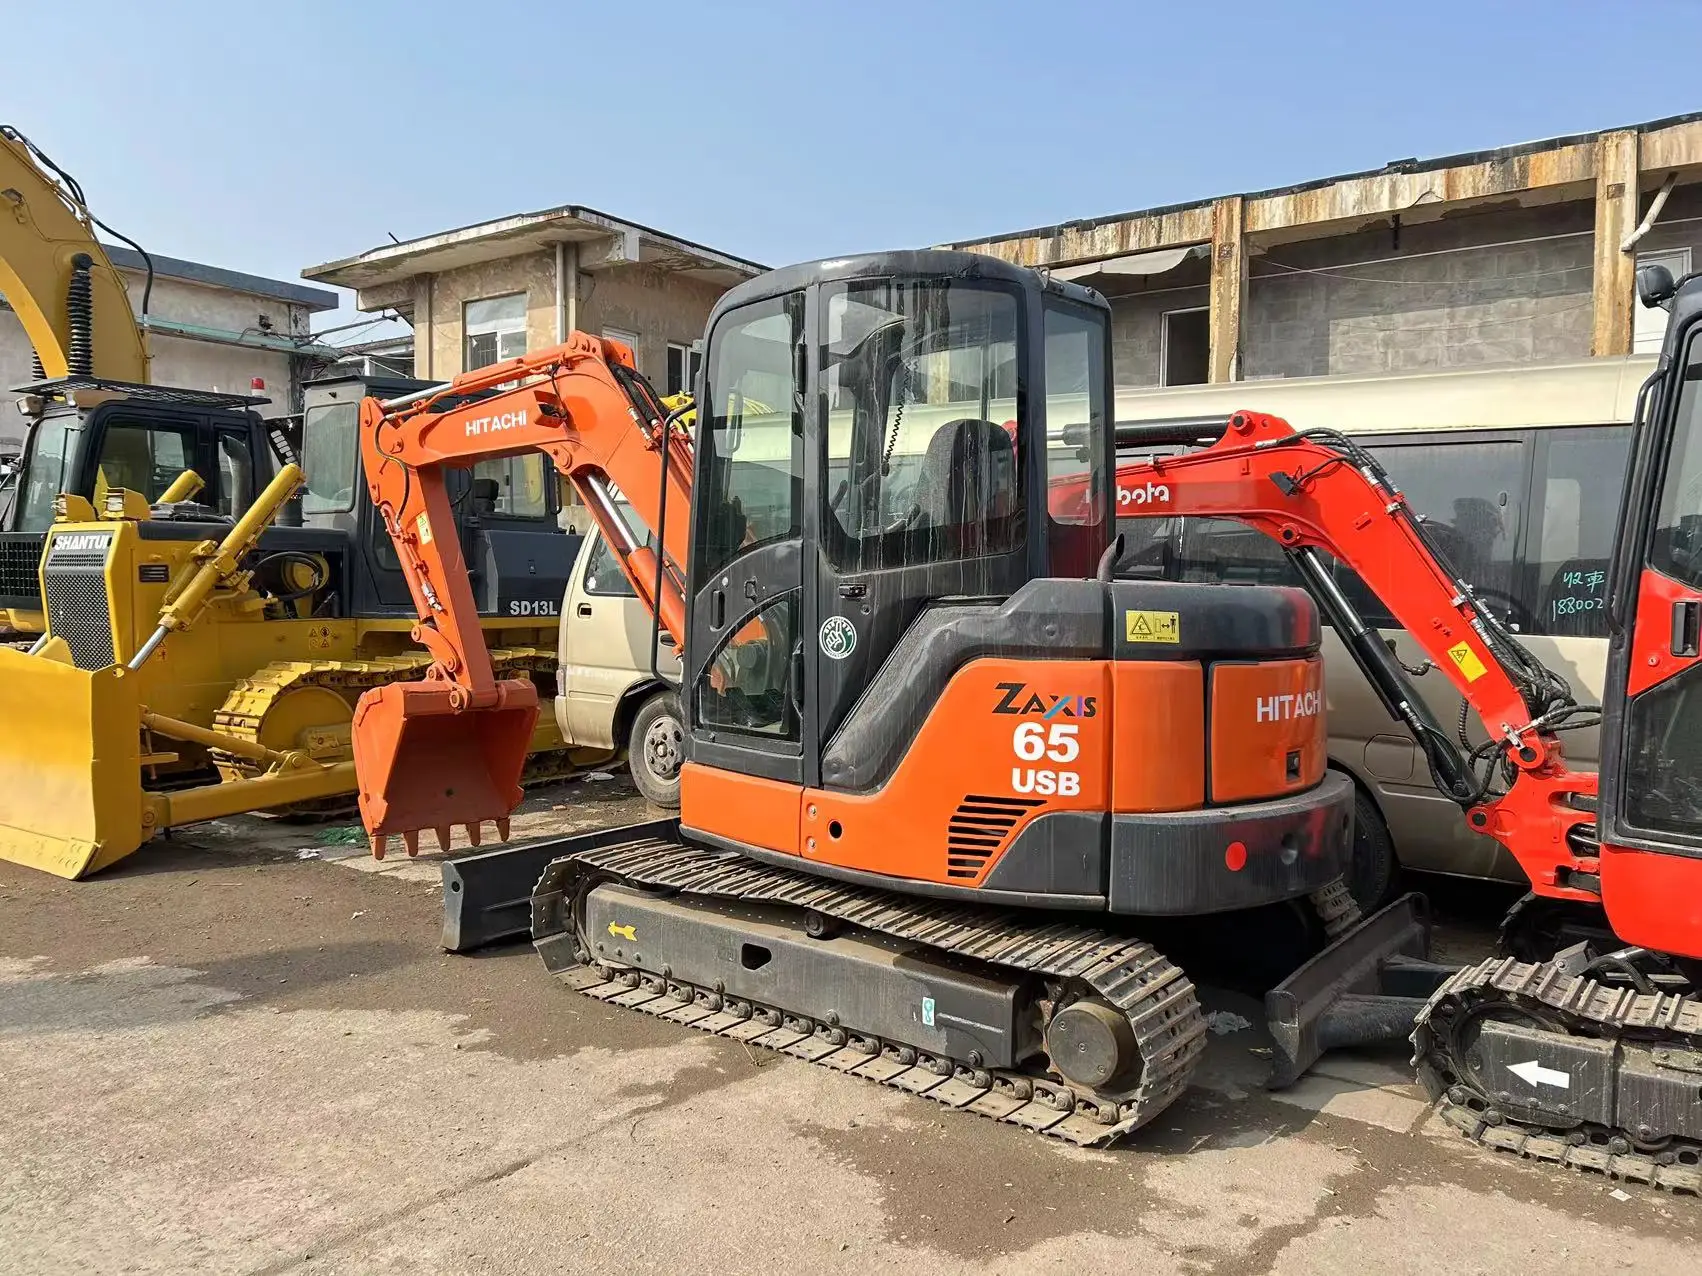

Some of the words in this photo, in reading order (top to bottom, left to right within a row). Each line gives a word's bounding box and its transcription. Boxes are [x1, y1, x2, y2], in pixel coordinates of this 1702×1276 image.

[465, 410, 527, 437] HITACHI
[1116, 482, 1170, 506] bota
[54, 535, 110, 551] SHANTUI
[510, 600, 558, 616] SD13L
[1552, 596, 1604, 622] 188002
[1013, 721, 1080, 763] 65
[1011, 767, 1081, 796] USB
